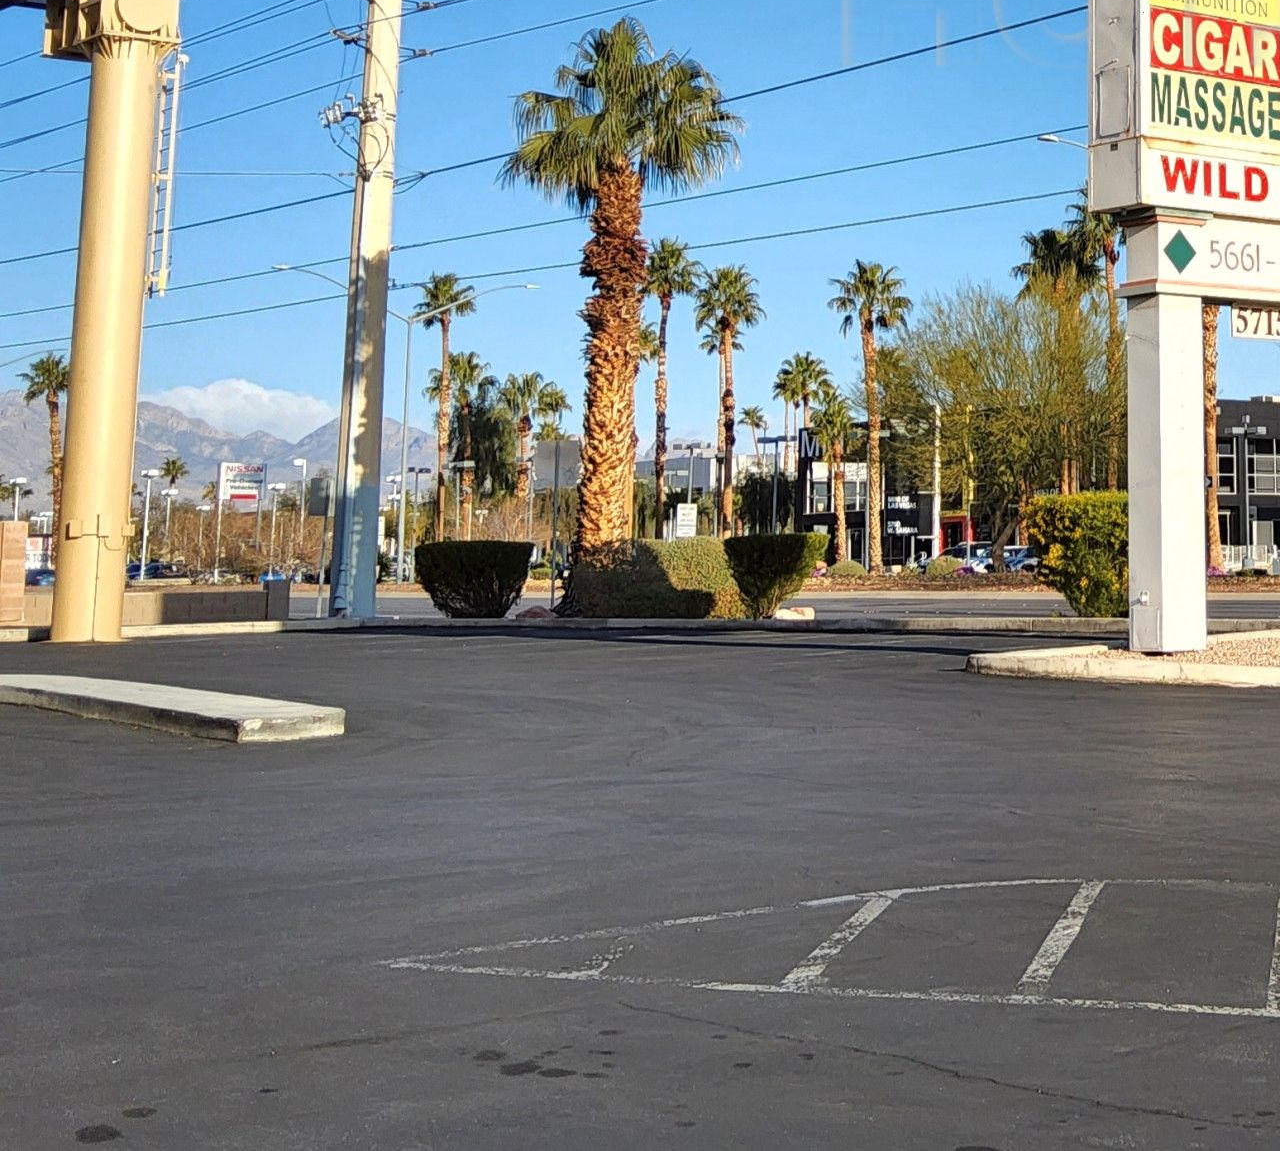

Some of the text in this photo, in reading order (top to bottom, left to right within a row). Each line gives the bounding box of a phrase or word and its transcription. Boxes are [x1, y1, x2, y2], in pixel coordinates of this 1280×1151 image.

[1152, 12, 1279, 81] CIGAR
[1160, 154, 1269, 203] WILD
[226, 465, 264, 473] NISSAN
